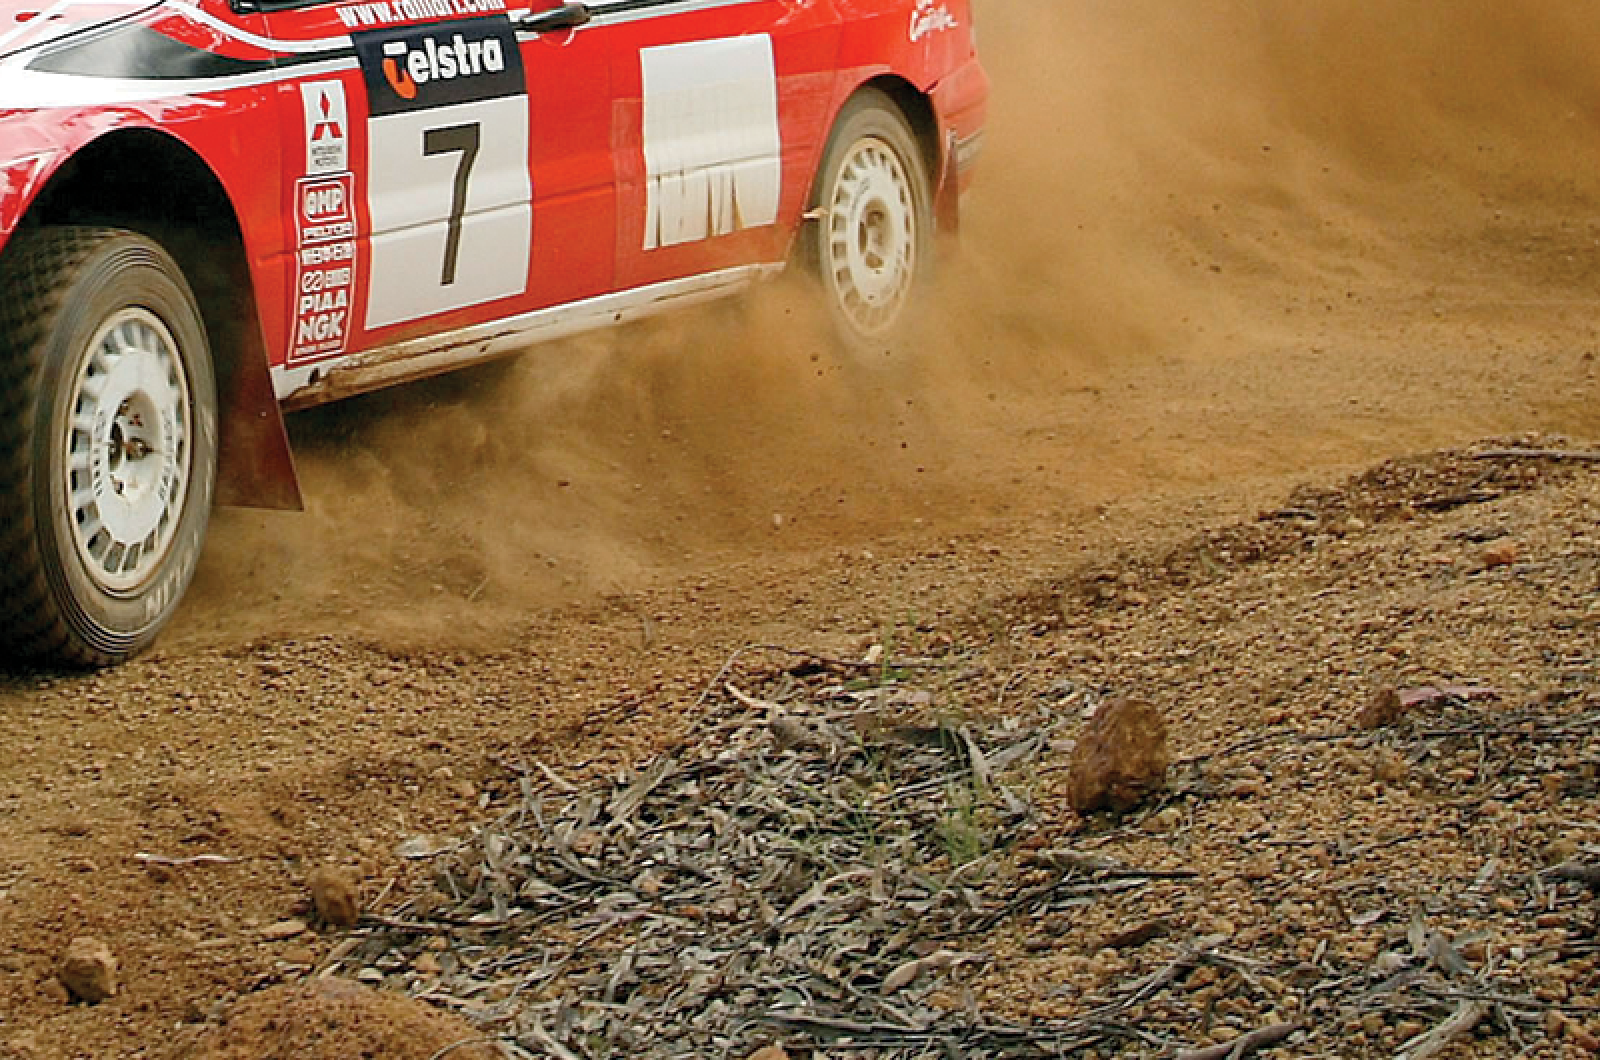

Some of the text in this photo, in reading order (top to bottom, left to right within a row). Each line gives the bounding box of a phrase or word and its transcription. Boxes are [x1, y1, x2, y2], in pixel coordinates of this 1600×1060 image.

[382, 34, 506, 99] Telstra
[423, 122, 480, 286] 7
[300, 290, 346, 315] PIAA
[298, 311, 345, 344] NGK
